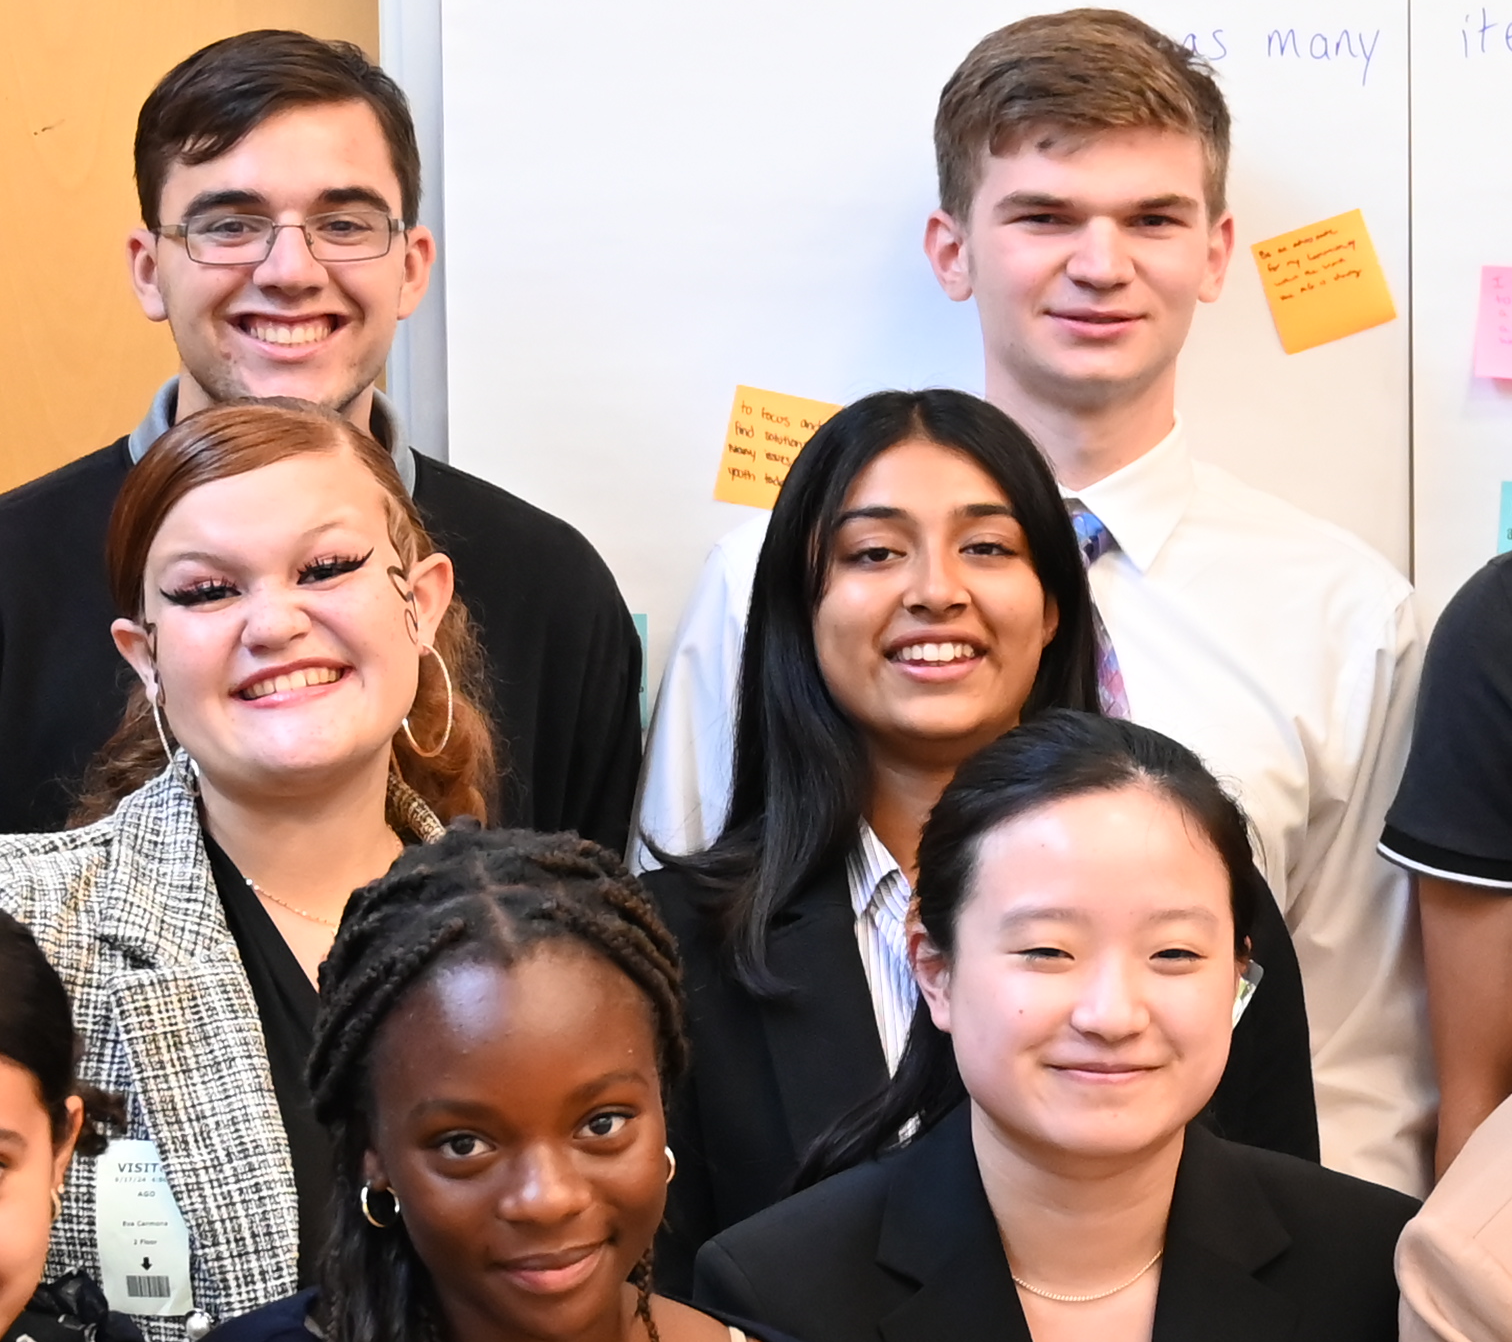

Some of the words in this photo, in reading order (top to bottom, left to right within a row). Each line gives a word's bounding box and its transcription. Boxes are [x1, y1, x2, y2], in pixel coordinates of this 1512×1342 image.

[1268, 29, 1380, 86] many
[741, 400, 753, 416] to
[735, 421, 755, 438] find
